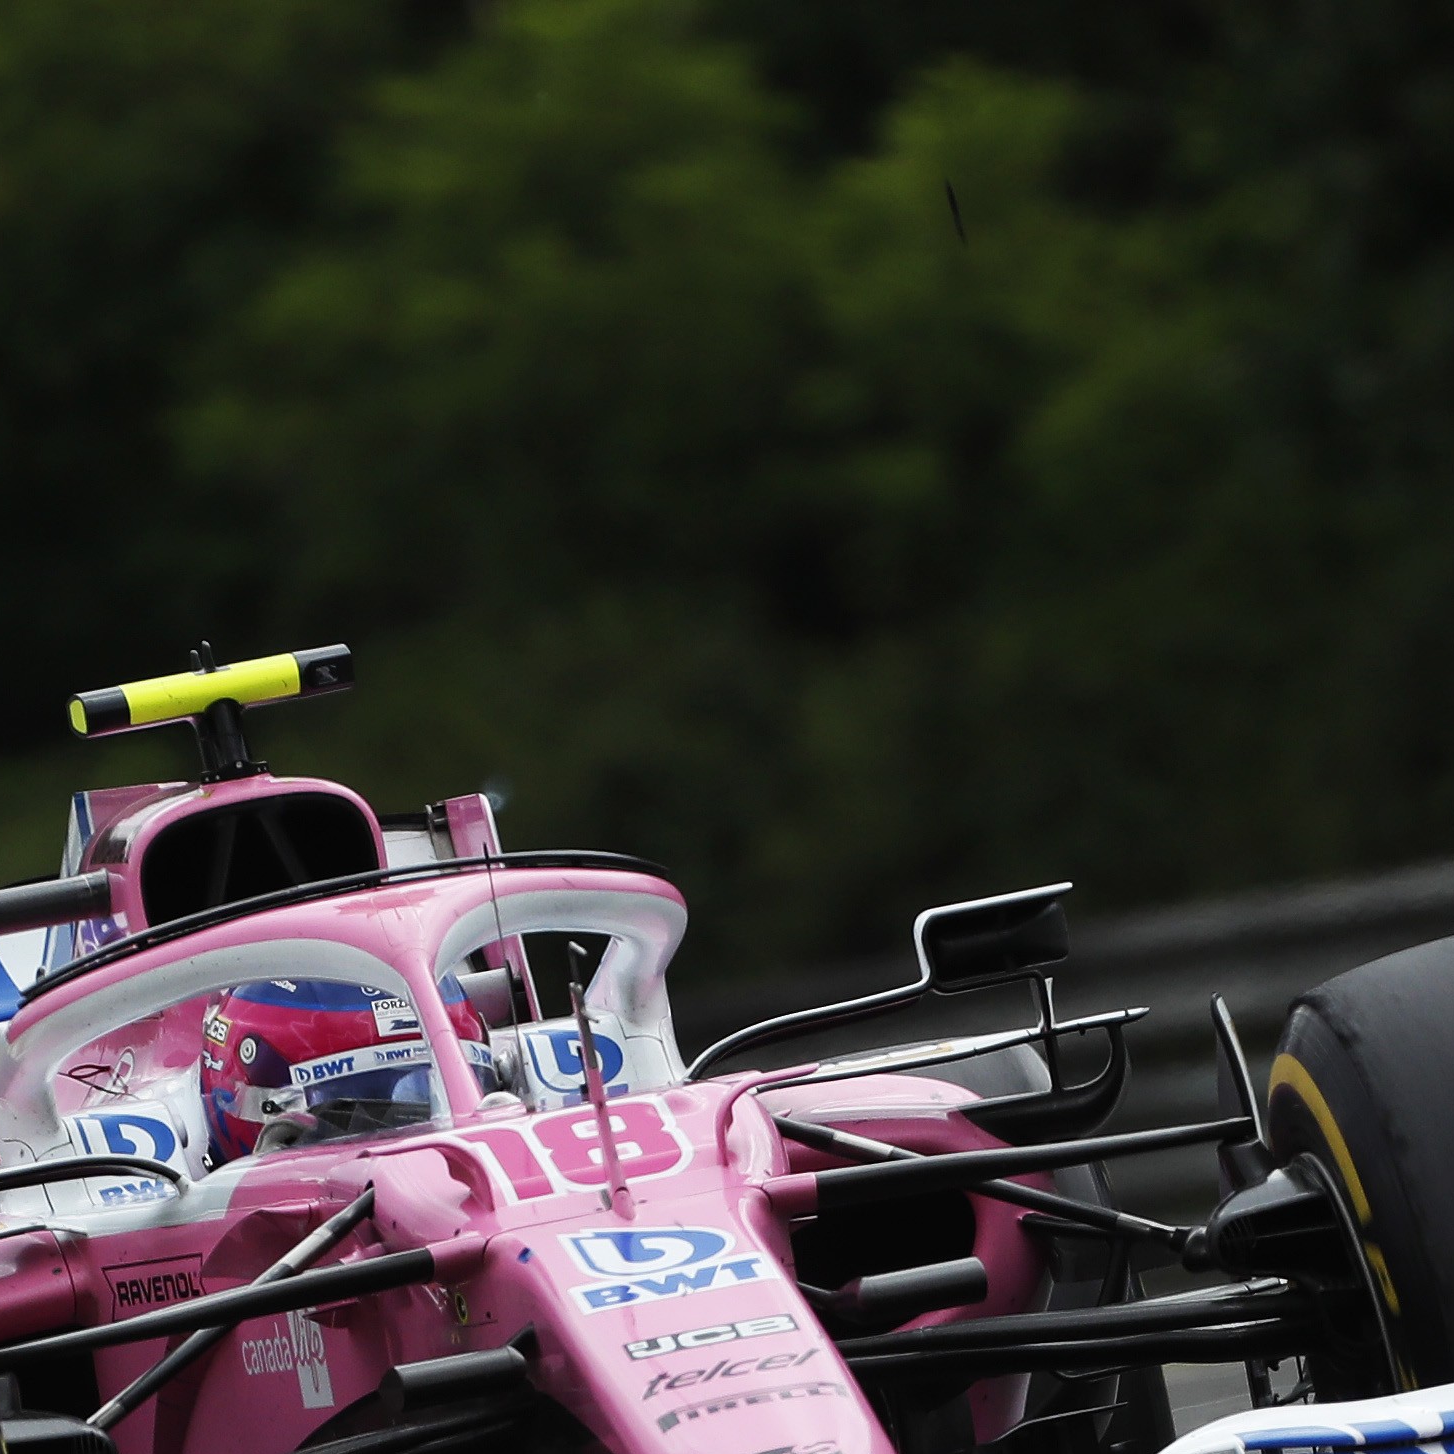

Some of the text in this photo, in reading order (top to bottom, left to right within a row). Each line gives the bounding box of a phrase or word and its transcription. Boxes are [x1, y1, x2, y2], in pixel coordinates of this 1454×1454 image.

[313, 1056, 355, 1080] BWT
[385, 1048, 412, 1061] BWT
[452, 1100, 689, 1203] 18
[116, 1271, 200, 1307] RAVENOL
[582, 1257, 762, 1309] BWT
[241, 1321, 294, 1375] canada
[626, 1314, 799, 1360] JCB
[642, 1347, 820, 1401] telcel
[657, 1381, 850, 1434] PIRELLI
